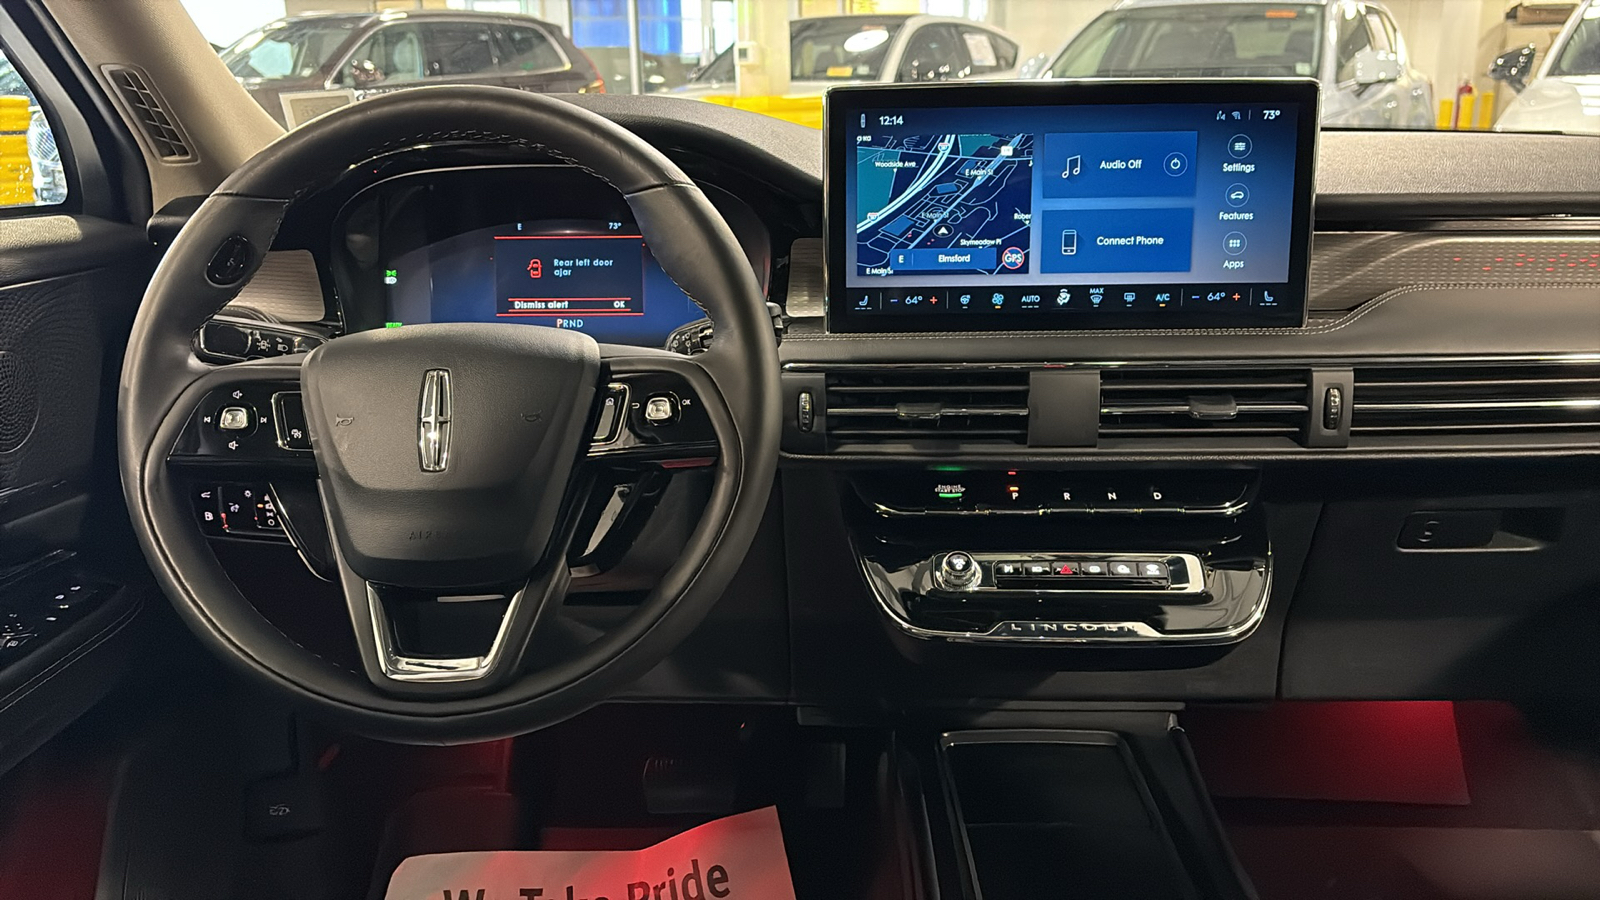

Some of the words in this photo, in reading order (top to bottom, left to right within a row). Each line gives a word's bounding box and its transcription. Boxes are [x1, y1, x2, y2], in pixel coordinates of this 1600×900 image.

[1263, 110, 1281, 120] 73°
[879, 116, 904, 125] 12:14
[875, 160, 902, 168] Woodside
[903, 160, 916, 168] Ave
[1100, 160, 1126, 170] Audio
[1128, 160, 1142, 169] Off
[1223, 163, 1255, 173] Settings
[1219, 211, 1254, 221] Features
[1097, 236, 1134, 245] Connect
[1136, 236, 1164, 245] Phone
[898, 255, 904, 263] E
[938, 254, 971, 264] Elmsford
[1004, 253, 1023, 264] GPS
[1223, 260, 1244, 270] Apps
[554, 269, 571, 277] ajar
[905, 296, 923, 305] 64°
[1021, 294, 1041, 304] AUTO
[1155, 293, 1170, 302] A/C
[1206, 292, 1226, 302] 64°
[514, 301, 546, 309] Dismiss
[548, 301, 569, 309] alert
[556, 319, 584, 328] PRND
[1153, 492, 1162, 500] D
[1010, 623, 1138, 632] LINCOLN
